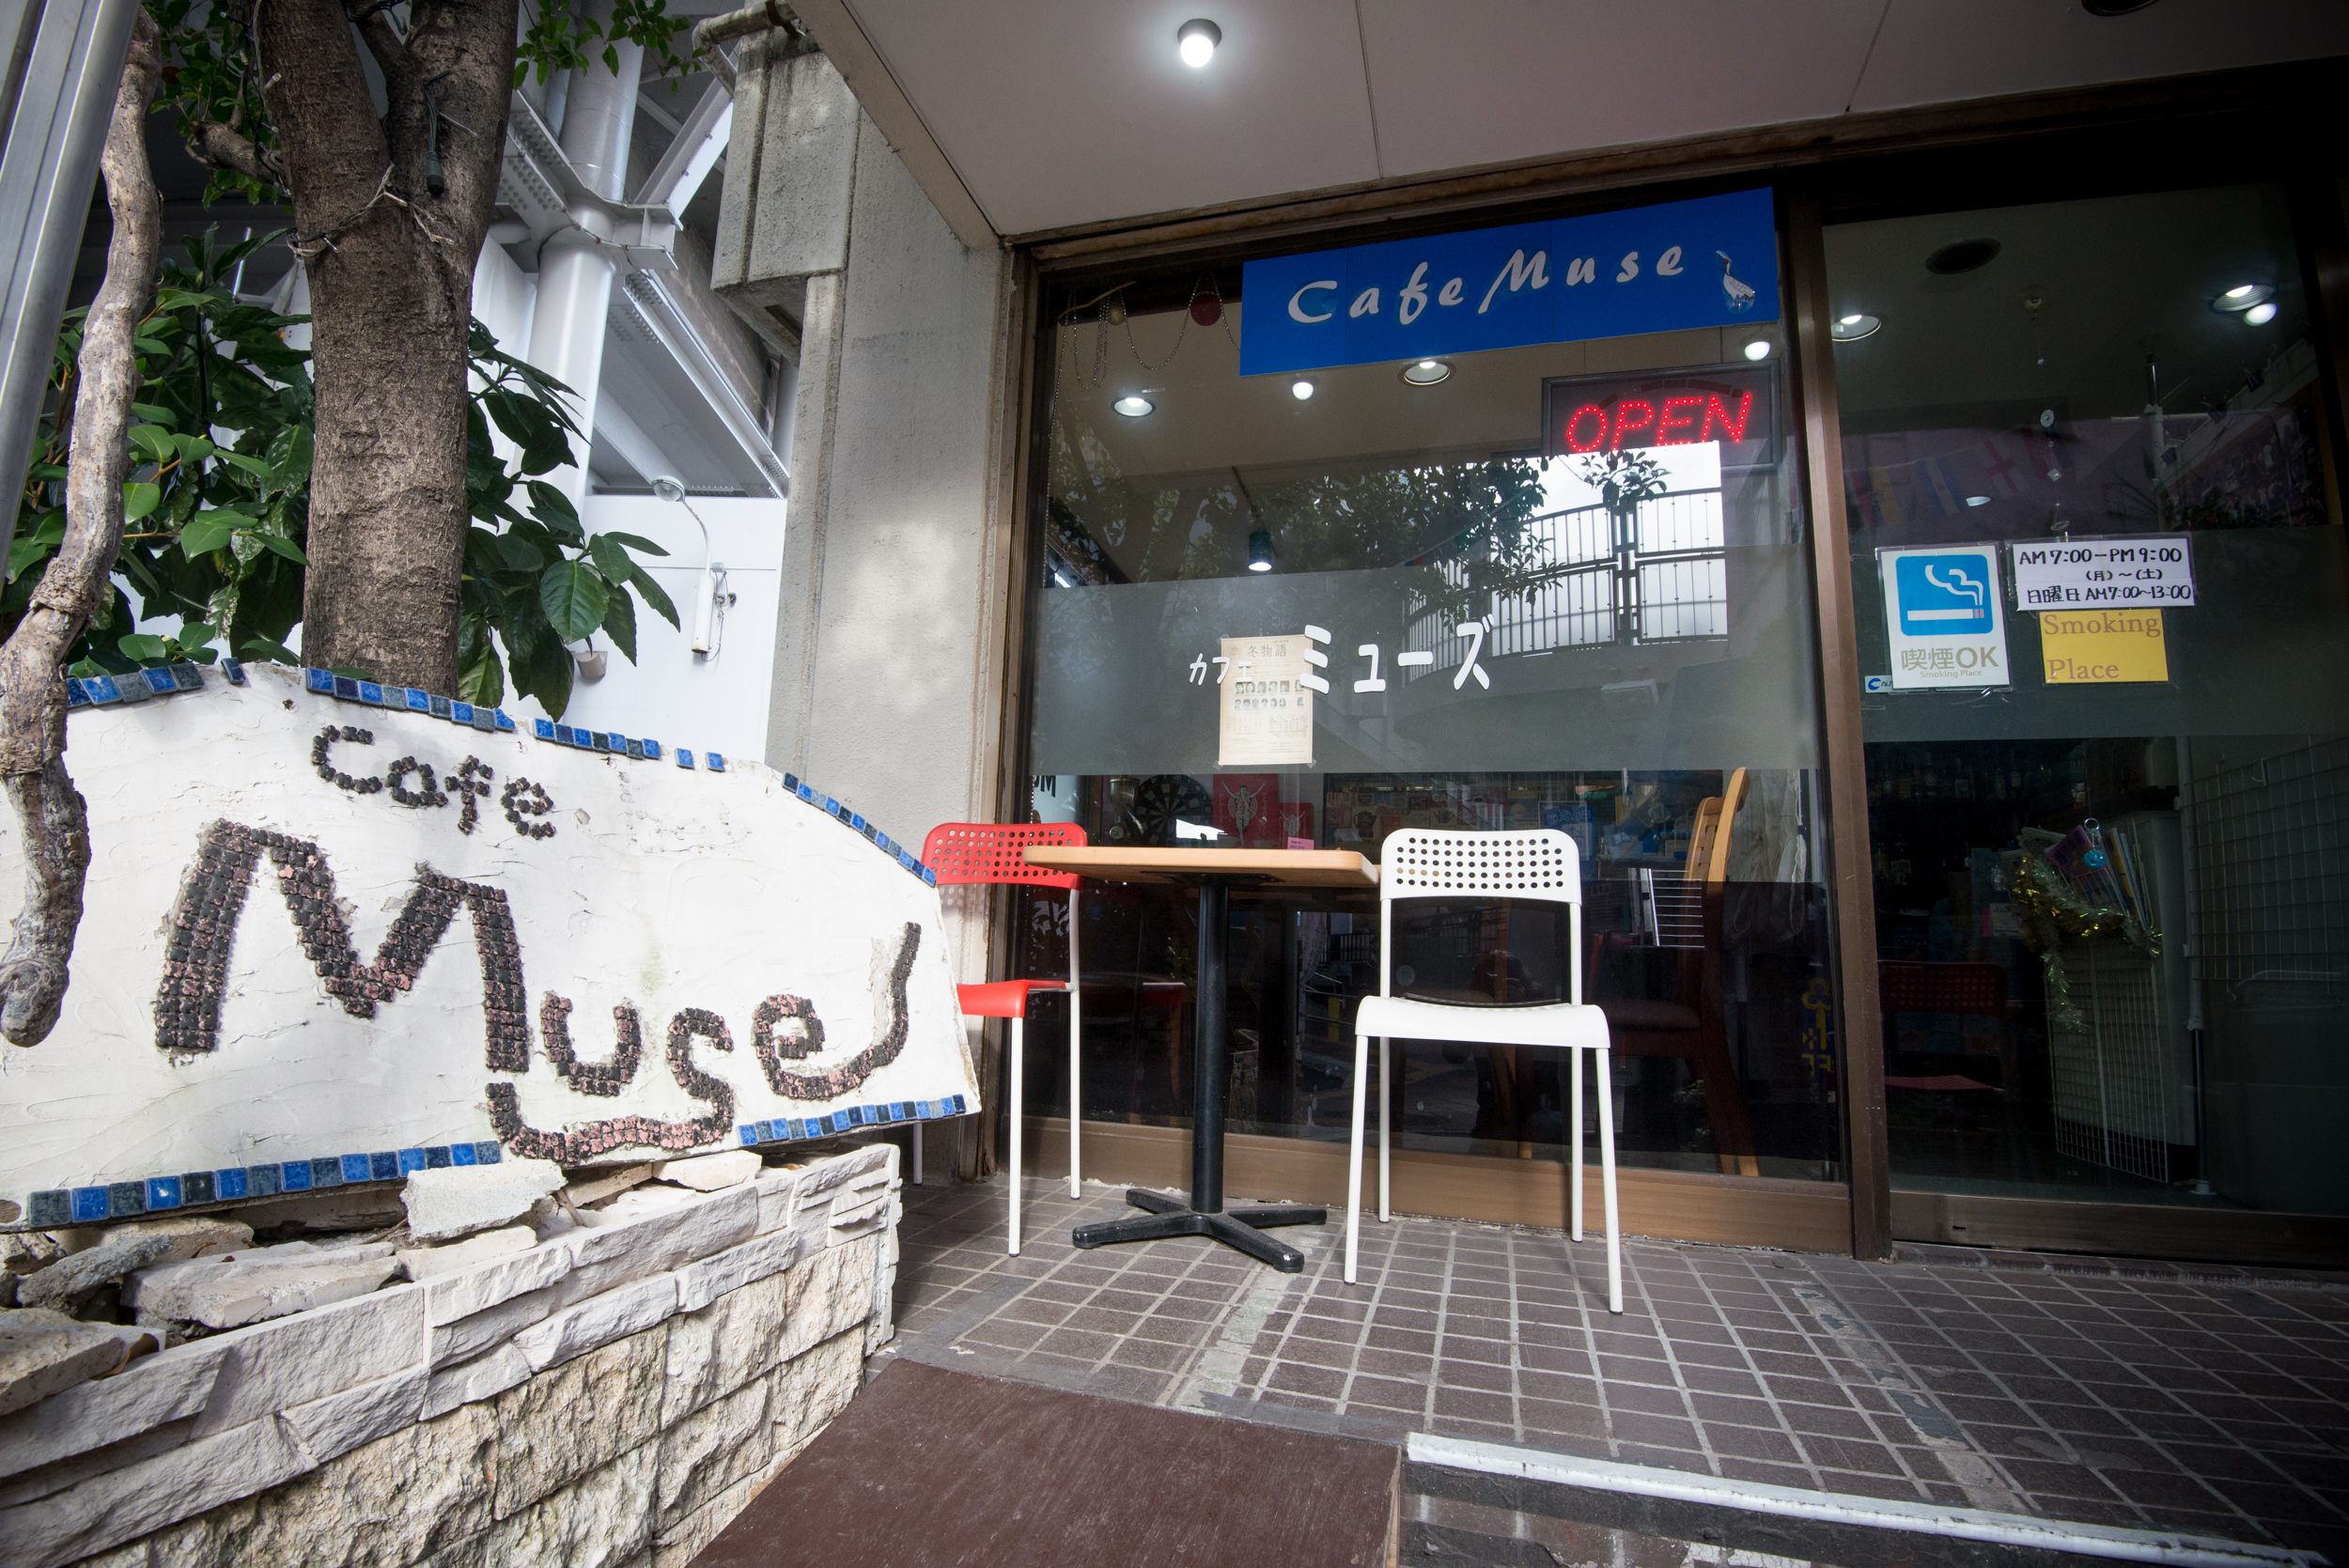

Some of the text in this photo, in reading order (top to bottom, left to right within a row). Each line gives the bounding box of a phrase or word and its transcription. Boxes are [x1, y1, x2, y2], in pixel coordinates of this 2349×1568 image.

[1287, 245, 1686, 326] Cafe Muse
[1566, 392, 1753, 454] OPEN
[2027, 584, 2081, 604] 日曜日
[2044, 612, 2161, 638] Smoking
[1247, 643, 1287, 660] 冬物語
[1299, 613, 1495, 695] ミューズ
[1900, 645, 1999, 672] 喫煙OK
[1920, 669, 1983, 679] Smoking Place
[2046, 658, 2120, 680] Place
[310, 723, 556, 839] Cafe
[153, 816, 922, 1167] Muse
